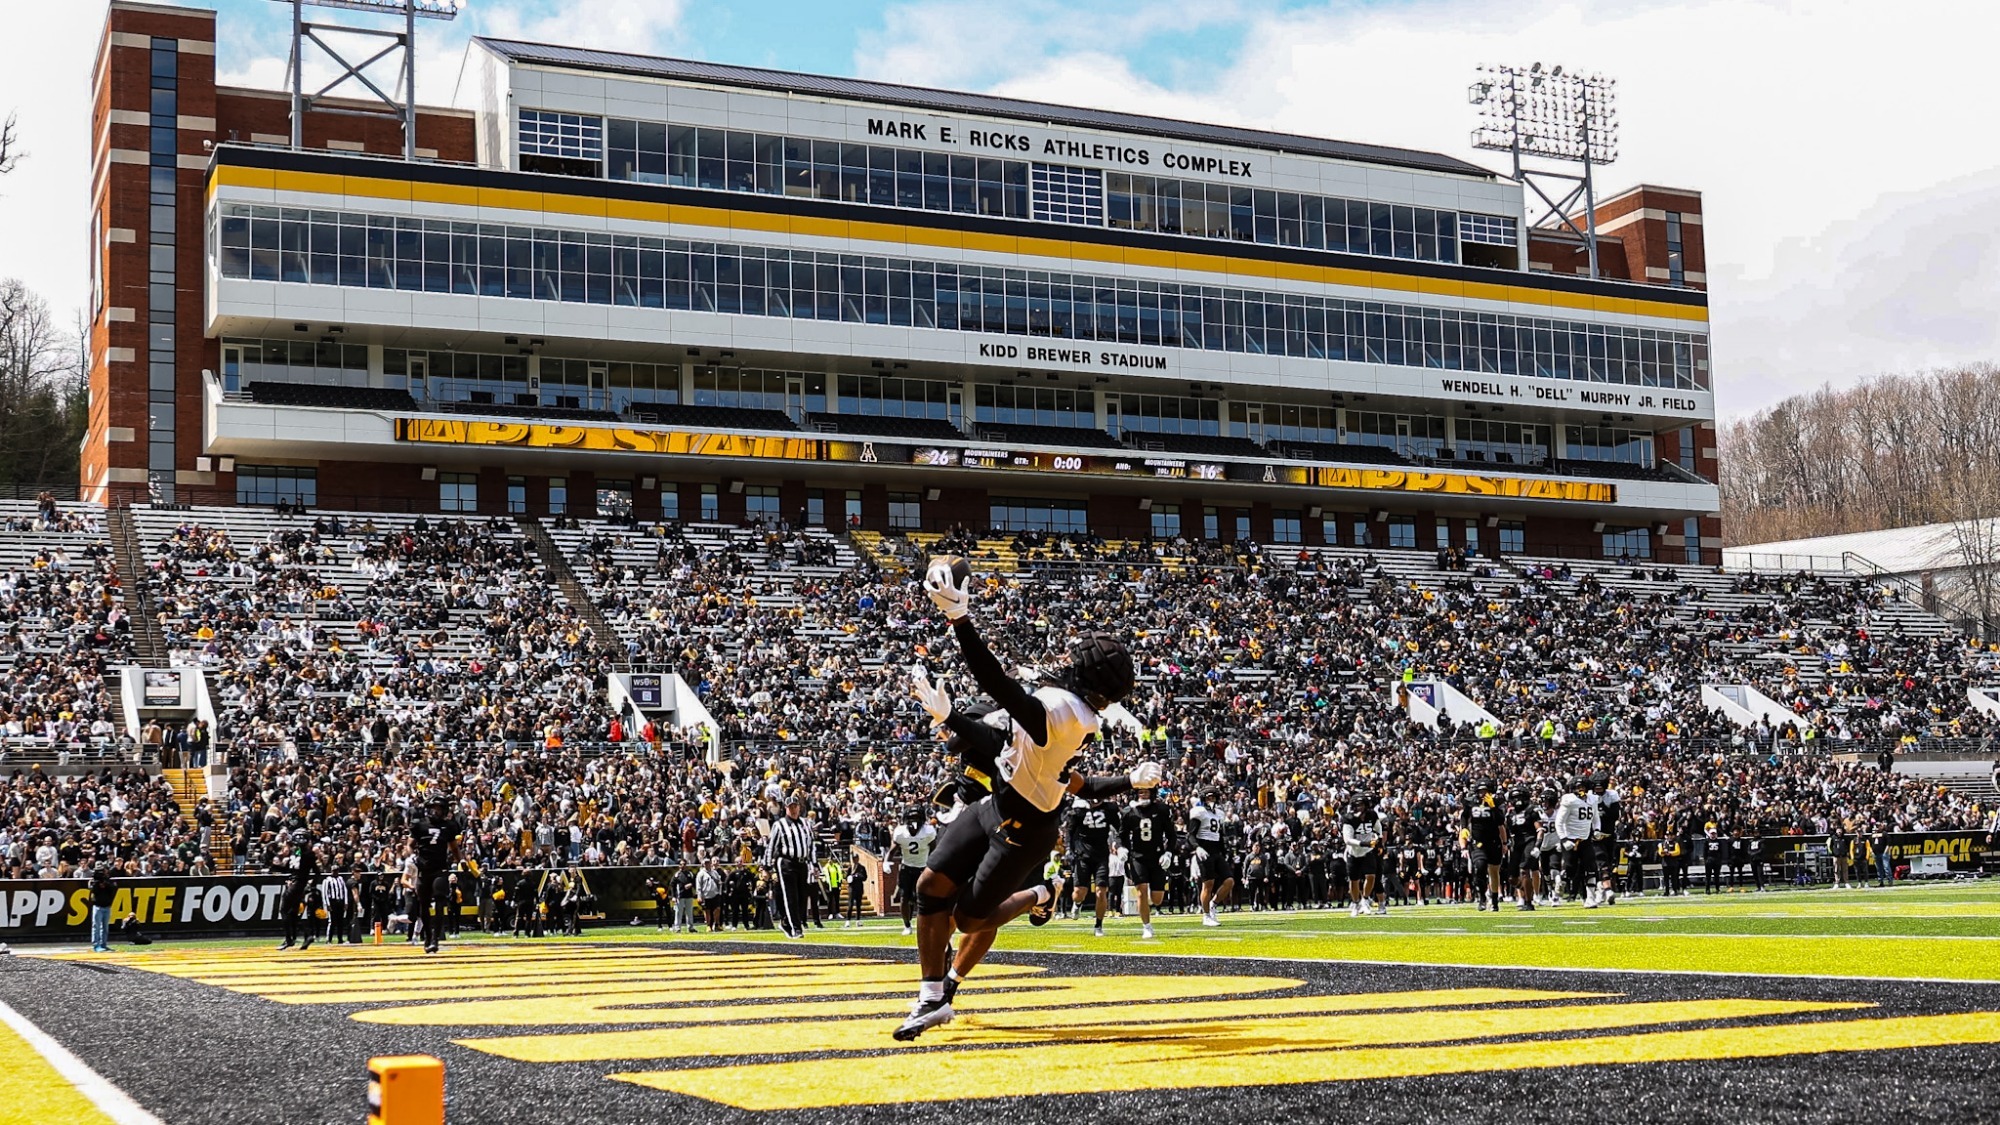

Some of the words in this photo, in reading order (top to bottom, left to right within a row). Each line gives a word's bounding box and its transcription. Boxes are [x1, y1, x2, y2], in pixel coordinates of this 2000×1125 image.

[868, 119, 926, 141] MARK
[940, 127, 957, 144] E.
[970, 130, 1030, 152] RICKS
[1044, 139, 1150, 165] ATHLETICS
[1163, 152, 1252, 178] COMPLEX
[979, 343, 1018, 358] KIDD
[1027, 347, 1091, 364] BREWER
[1101, 352, 1167, 369] STADIUM
[1442, 379, 1504, 396] WENDELL
[1510, 386, 1523, 397] H.
[1528, 385, 1573, 401] "DELL"
[1580, 391, 1631, 406] MURPHY
[1638, 397, 1656, 408] JR.
[1662, 398, 1696, 411] FIELD
[860, 442, 877, 462] A
[929, 450, 949, 465] 26
[964, 449, 1009, 459] MOUNTAINEERS
[1034, 456, 1039, 466] 1
[1054, 457, 1082, 470] 0:00
[1144, 459, 1186, 467] MOUNTAINEERS
[1200, 465, 1216, 480] 16
[1263, 466, 1276, 482] A
[1083, 811, 1107, 828] 42
[1578, 807, 1593, 820] 66
[428, 828, 441, 844] 7
[1139, 818, 1152, 841] 8
[1356, 823, 1373, 834] 45
[908, 841, 919, 855] 2
[1902, 844, 1922, 855] THE
[1923, 837, 1973, 863] ROCK
[66, 886, 177, 926] SATE
